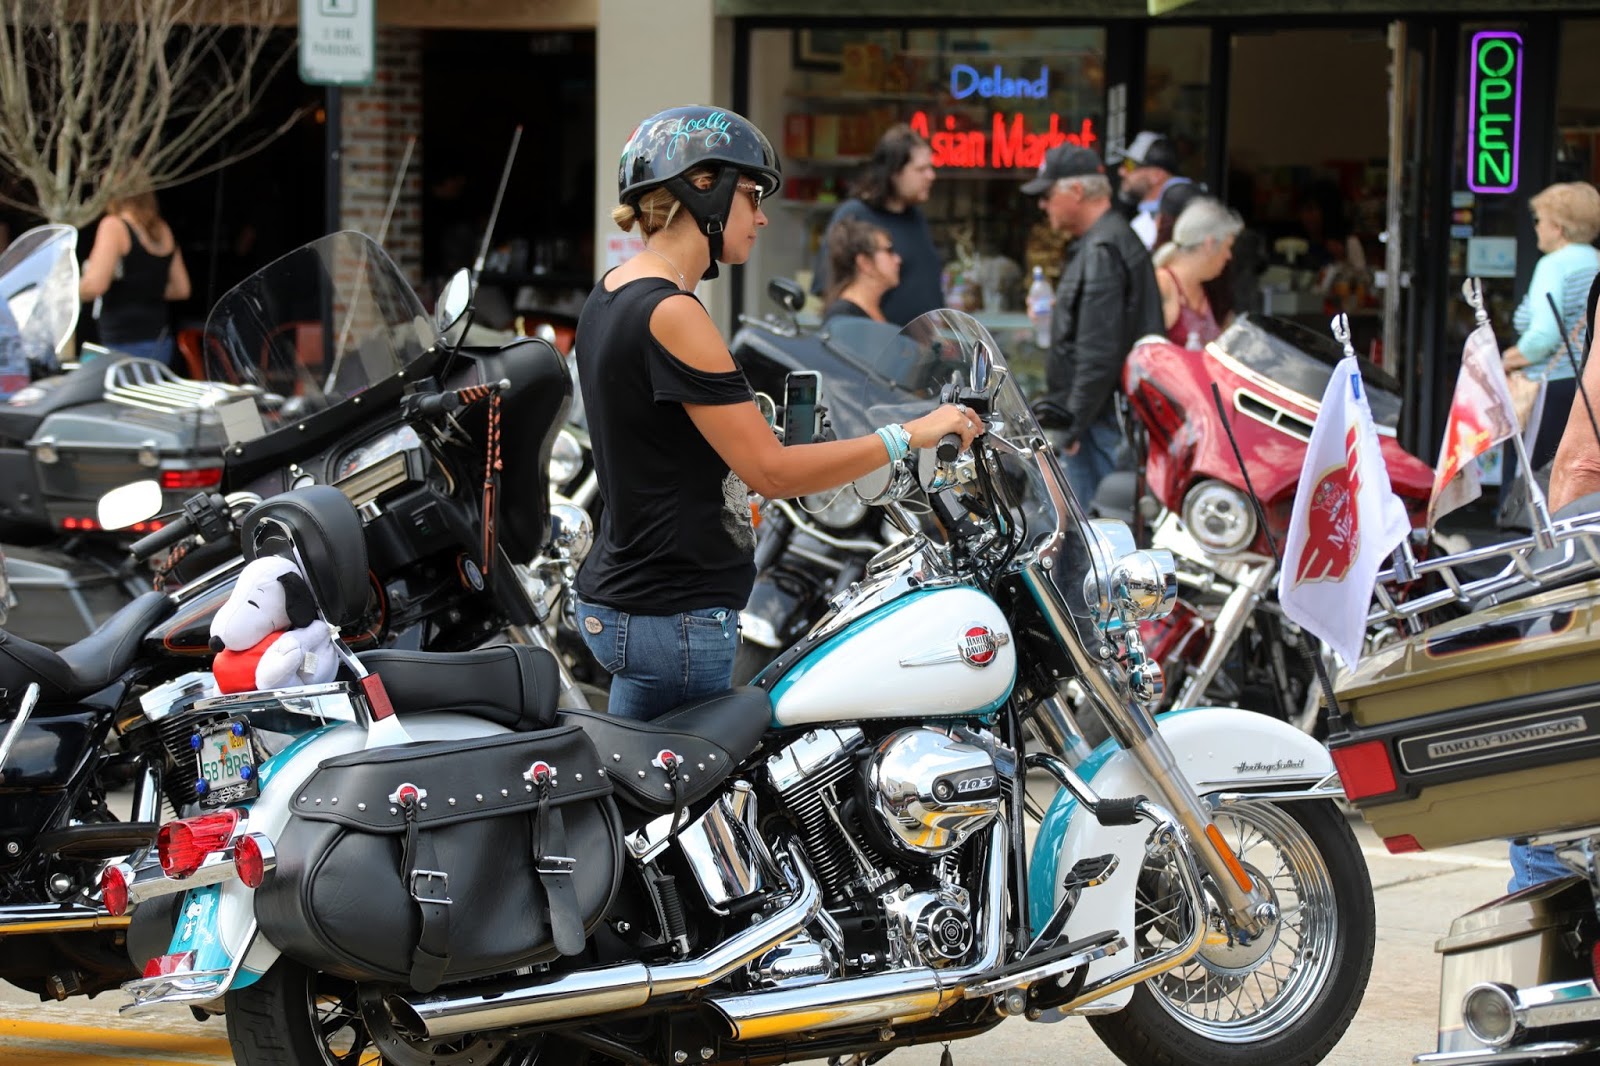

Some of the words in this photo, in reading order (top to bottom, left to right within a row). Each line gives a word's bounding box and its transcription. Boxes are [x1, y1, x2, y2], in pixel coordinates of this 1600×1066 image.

[951, 63, 1049, 99] Deland
[1478, 39, 1515, 184] OPEN
[1433, 719, 1581, 757] HARLEY-DAVIDSON
[957, 776, 994, 793] 103
